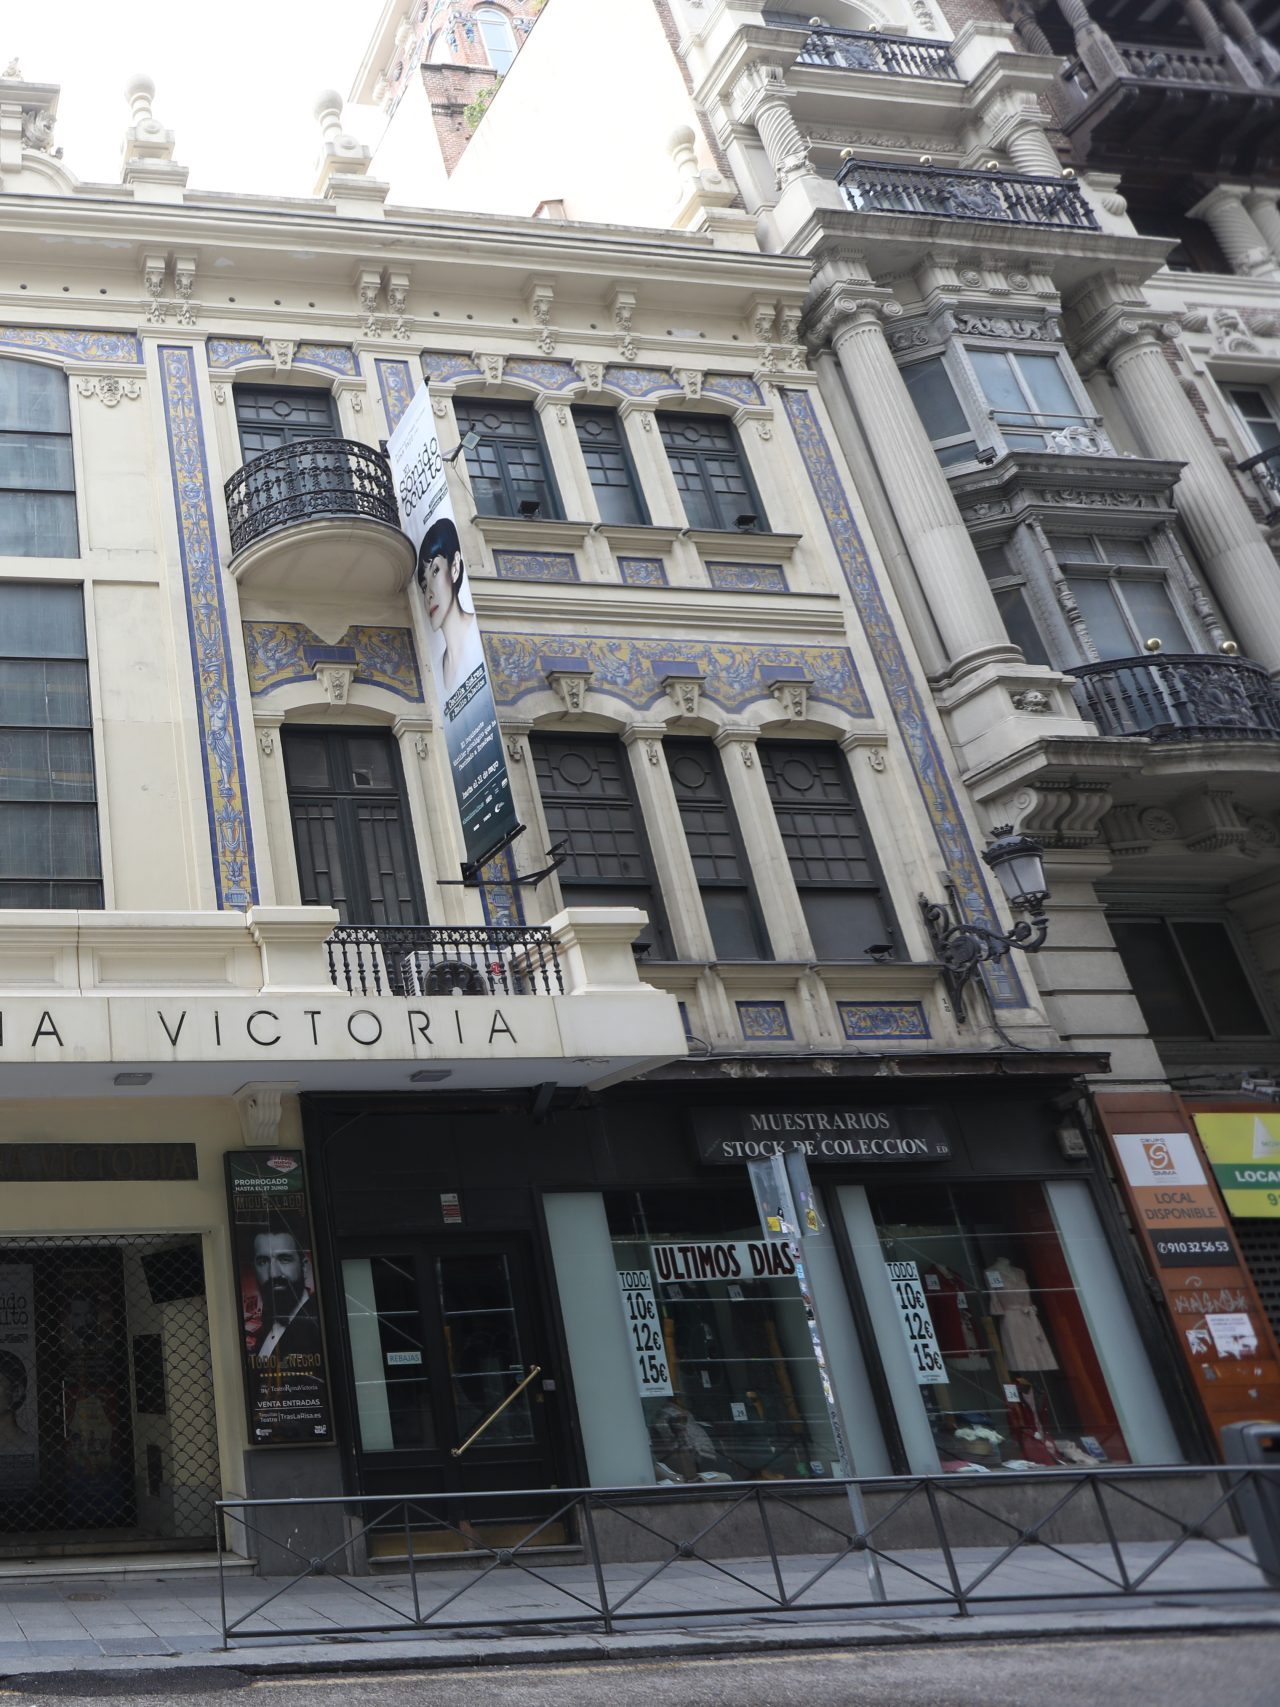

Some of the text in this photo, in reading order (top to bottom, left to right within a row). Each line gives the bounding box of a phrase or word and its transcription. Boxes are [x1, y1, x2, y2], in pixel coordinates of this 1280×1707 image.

[157, 1008, 518, 1046] VICTORIA
[750, 1112, 890, 1131] MUESTRARIOS
[722, 1140, 785, 1157] STOCK
[821, 1138, 929, 1155] COLECCION
[234, 1178, 288, 1186] PRORROGADO
[1234, 1170, 1280, 1183] LOCA
[1154, 1192, 1196, 1204] LOCAL
[1145, 1207, 1217, 1220] DISPONIBLE
[1168, 1242, 1187, 1253] 910
[654, 1241, 796, 1281] ULTIMOS DIAS
[887, 1262, 918, 1279] TODO:
[619, 1271, 651, 1289] TODO:
[896, 1282, 925, 1310] 10€
[626, 1292, 656, 1321] 10€
[904, 1312, 933, 1340] 12€
[632, 1323, 662, 1352] 12€
[288, 1353, 321, 1368] NEGRO
[388, 1353, 420, 1362] REBAJAS
[913, 1343, 942, 1371] 15€
[639, 1355, 668, 1384] 15€
[257, 1399, 321, 1408] VENTA ENTRADAS
